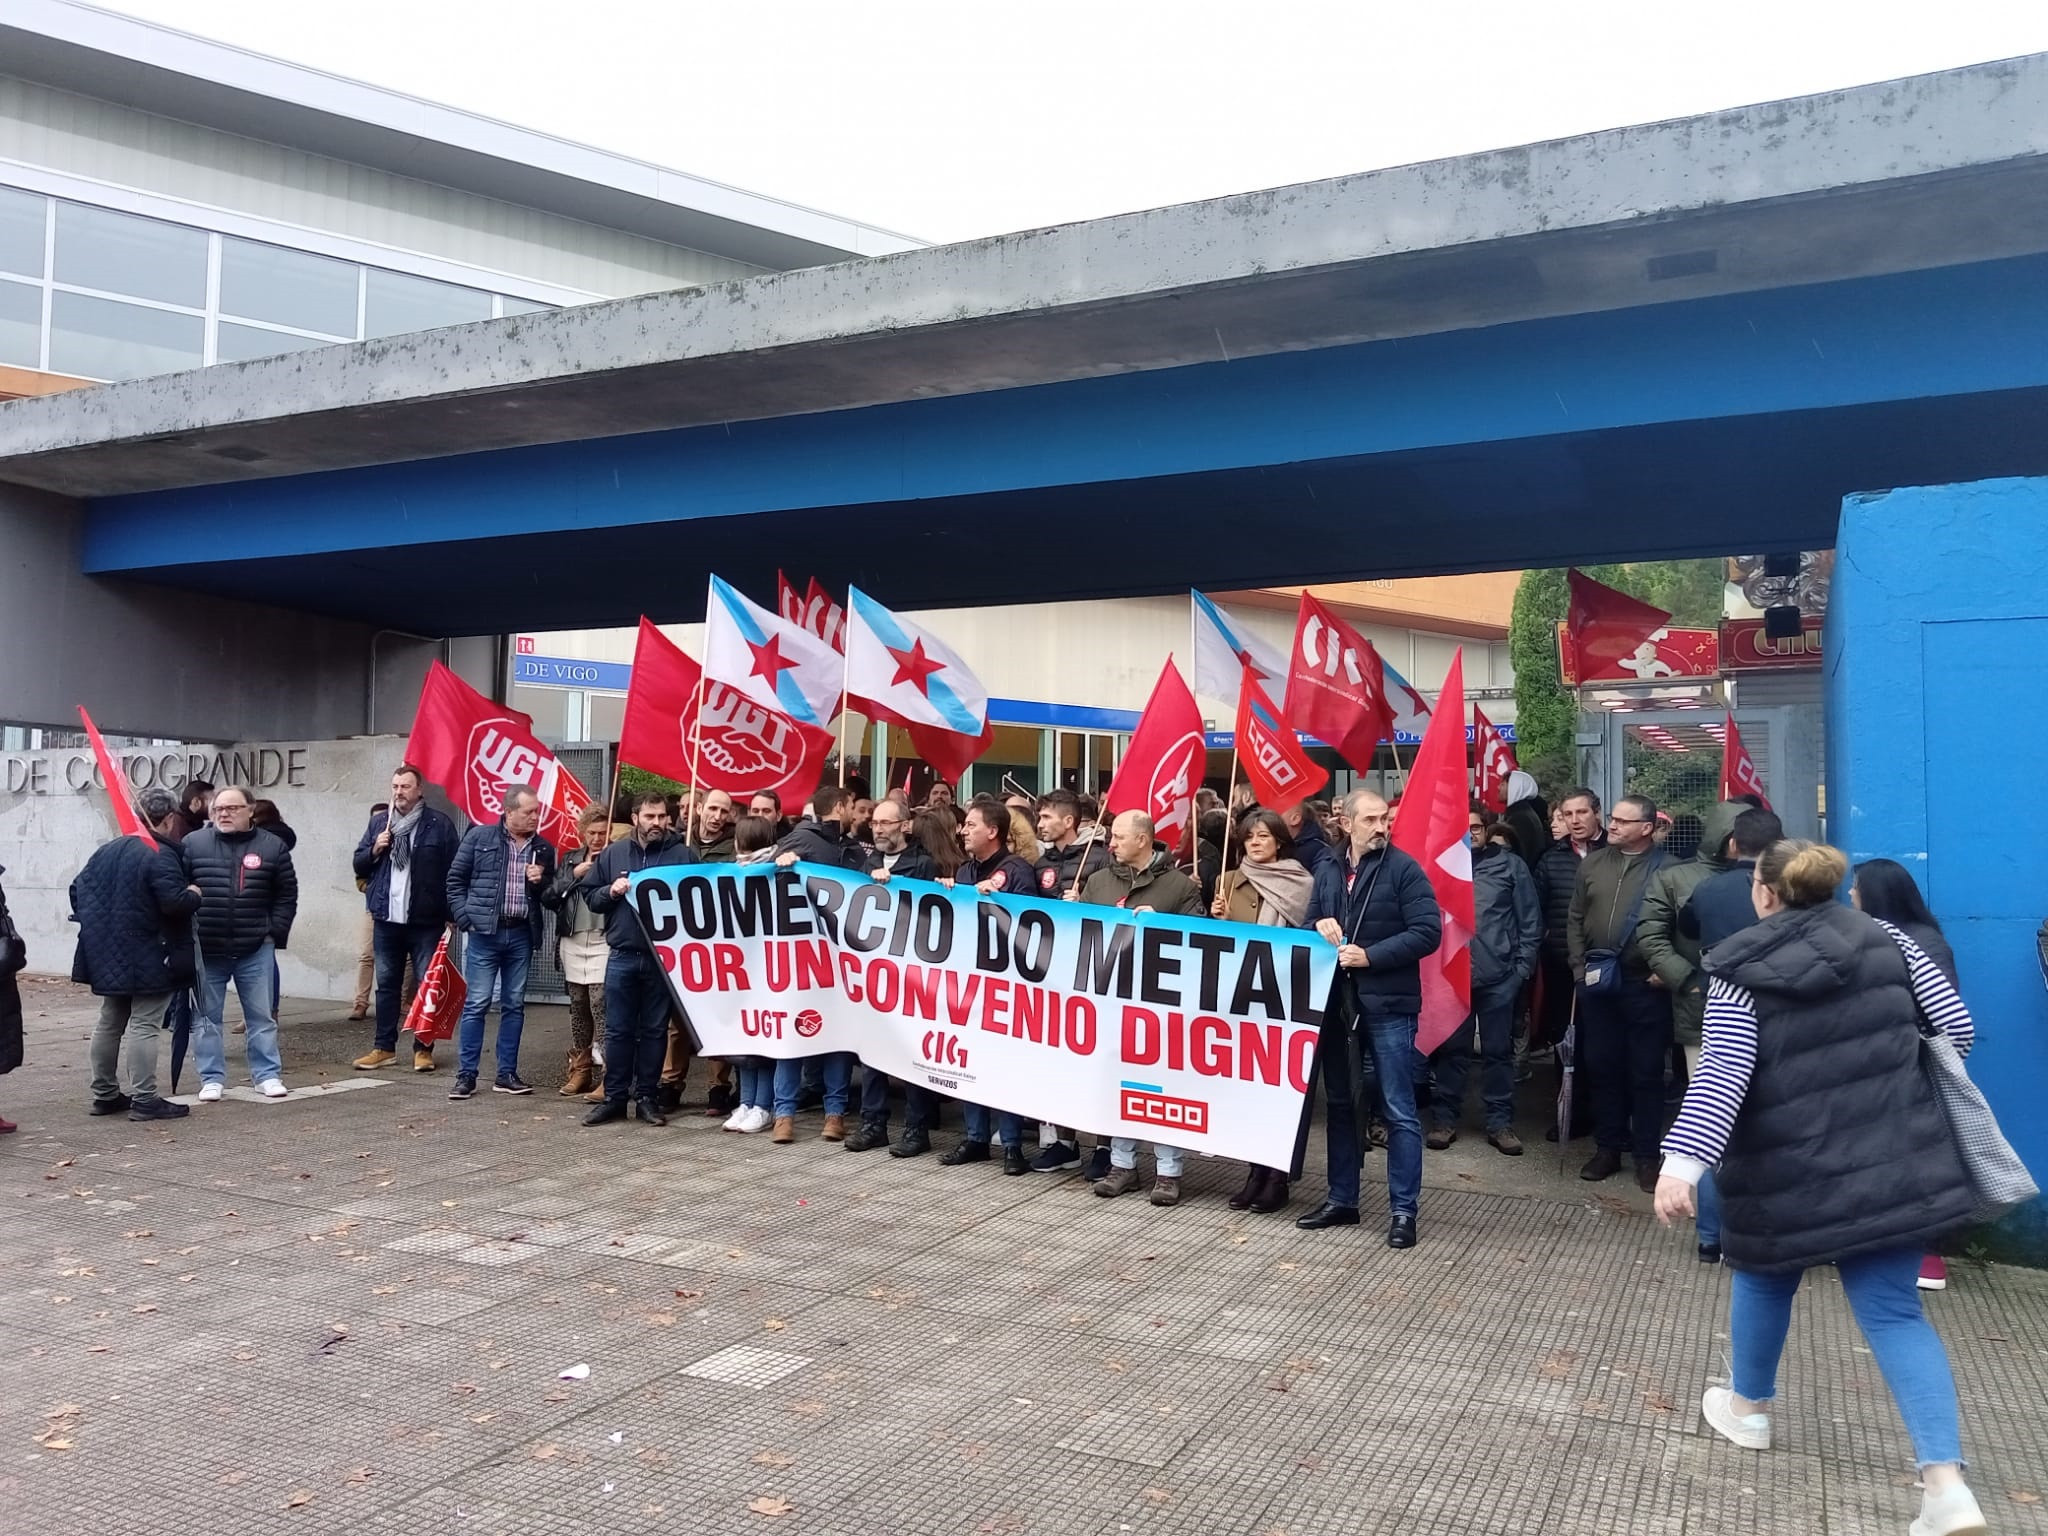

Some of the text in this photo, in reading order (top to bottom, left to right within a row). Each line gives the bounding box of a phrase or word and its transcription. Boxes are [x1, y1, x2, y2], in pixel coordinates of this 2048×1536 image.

[525, 661, 598, 681] DE VIGO
[700, 680, 794, 753] UGT
[7, 757, 48, 794] DE
[479, 728, 558, 808] UGT
[635, 871, 1325, 1028] COMERCIO DO METAL
[741, 1009, 788, 1040] UGT
[764, 939, 835, 993] UN
[838, 951, 1097, 1056] CONVENIO
[1121, 1005, 1320, 1095] DIGNO
[922, 1030, 968, 1068] CIG
[927, 1074, 958, 1090] SERVIZOS
[1126, 1096, 1203, 1128] CCOO
